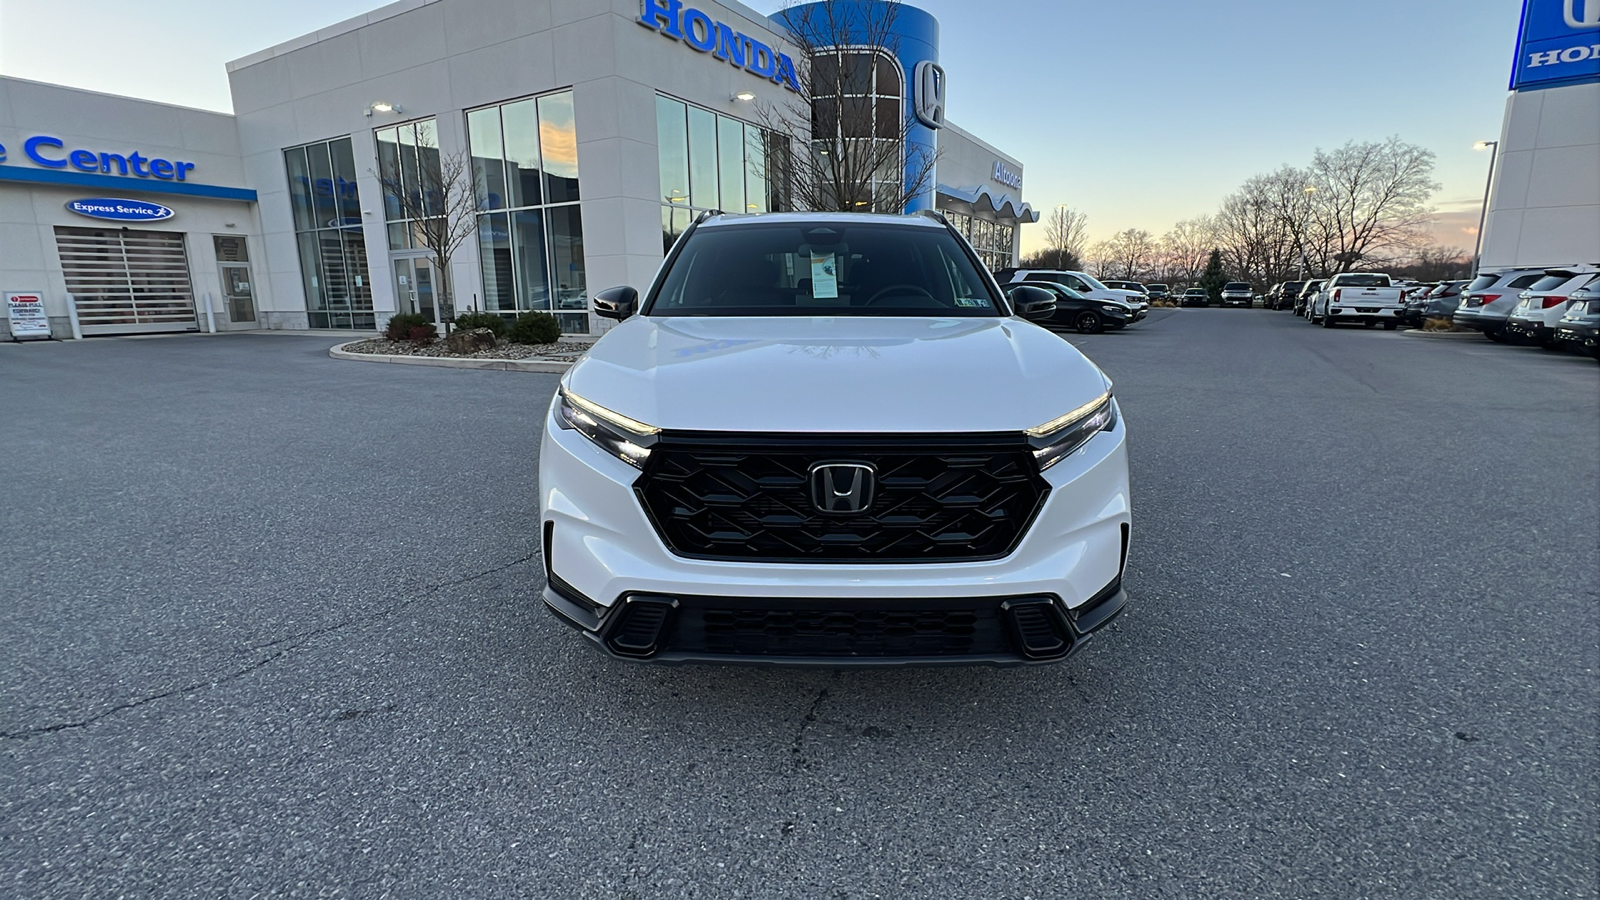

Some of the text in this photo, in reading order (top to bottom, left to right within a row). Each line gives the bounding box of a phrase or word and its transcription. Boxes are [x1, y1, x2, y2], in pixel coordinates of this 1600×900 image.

[638, 0, 801, 92] HONDA
[24, 135, 195, 181] Center
[73, 202, 153, 215] Express Service
